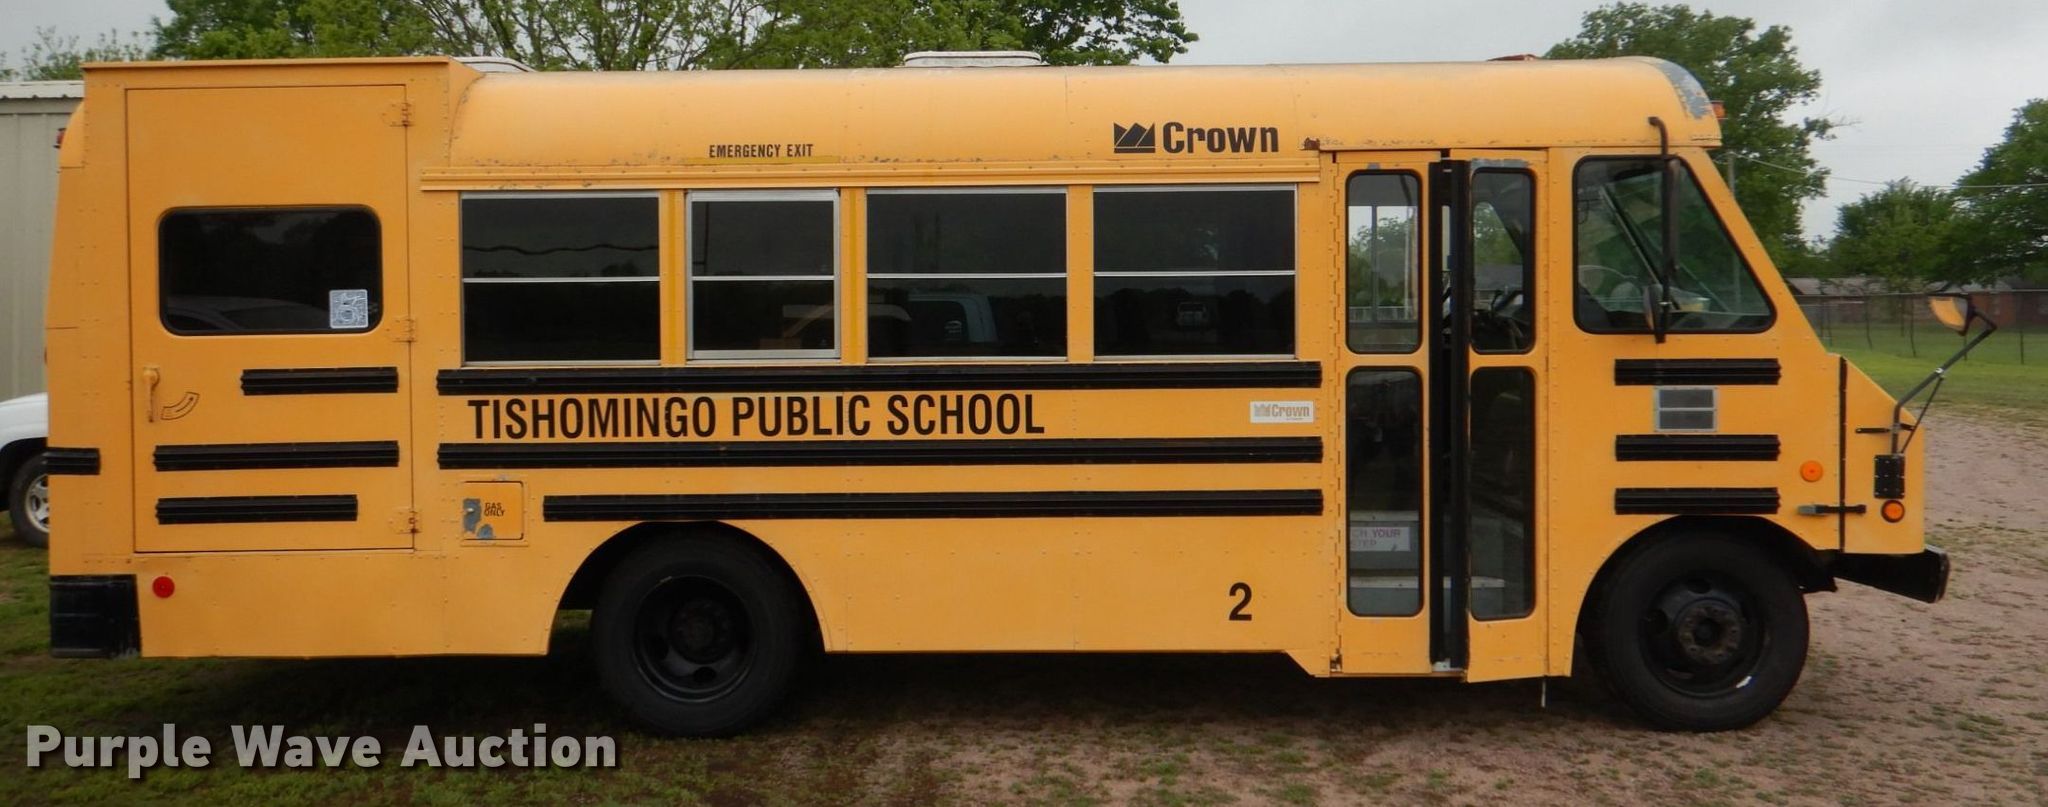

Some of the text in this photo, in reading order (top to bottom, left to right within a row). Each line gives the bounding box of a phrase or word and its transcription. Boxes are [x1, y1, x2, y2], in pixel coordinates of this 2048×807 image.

[1162, 121, 1279, 154] Crown
[708, 143, 814, 158] EMERGENCY EXIT
[467, 393, 1045, 439] TISHOMINGO PUBLIC SCHOOL
[1271, 404, 1310, 417] Crown
[484, 508, 505, 517] ONLY
[1229, 582, 1253, 621] 2
